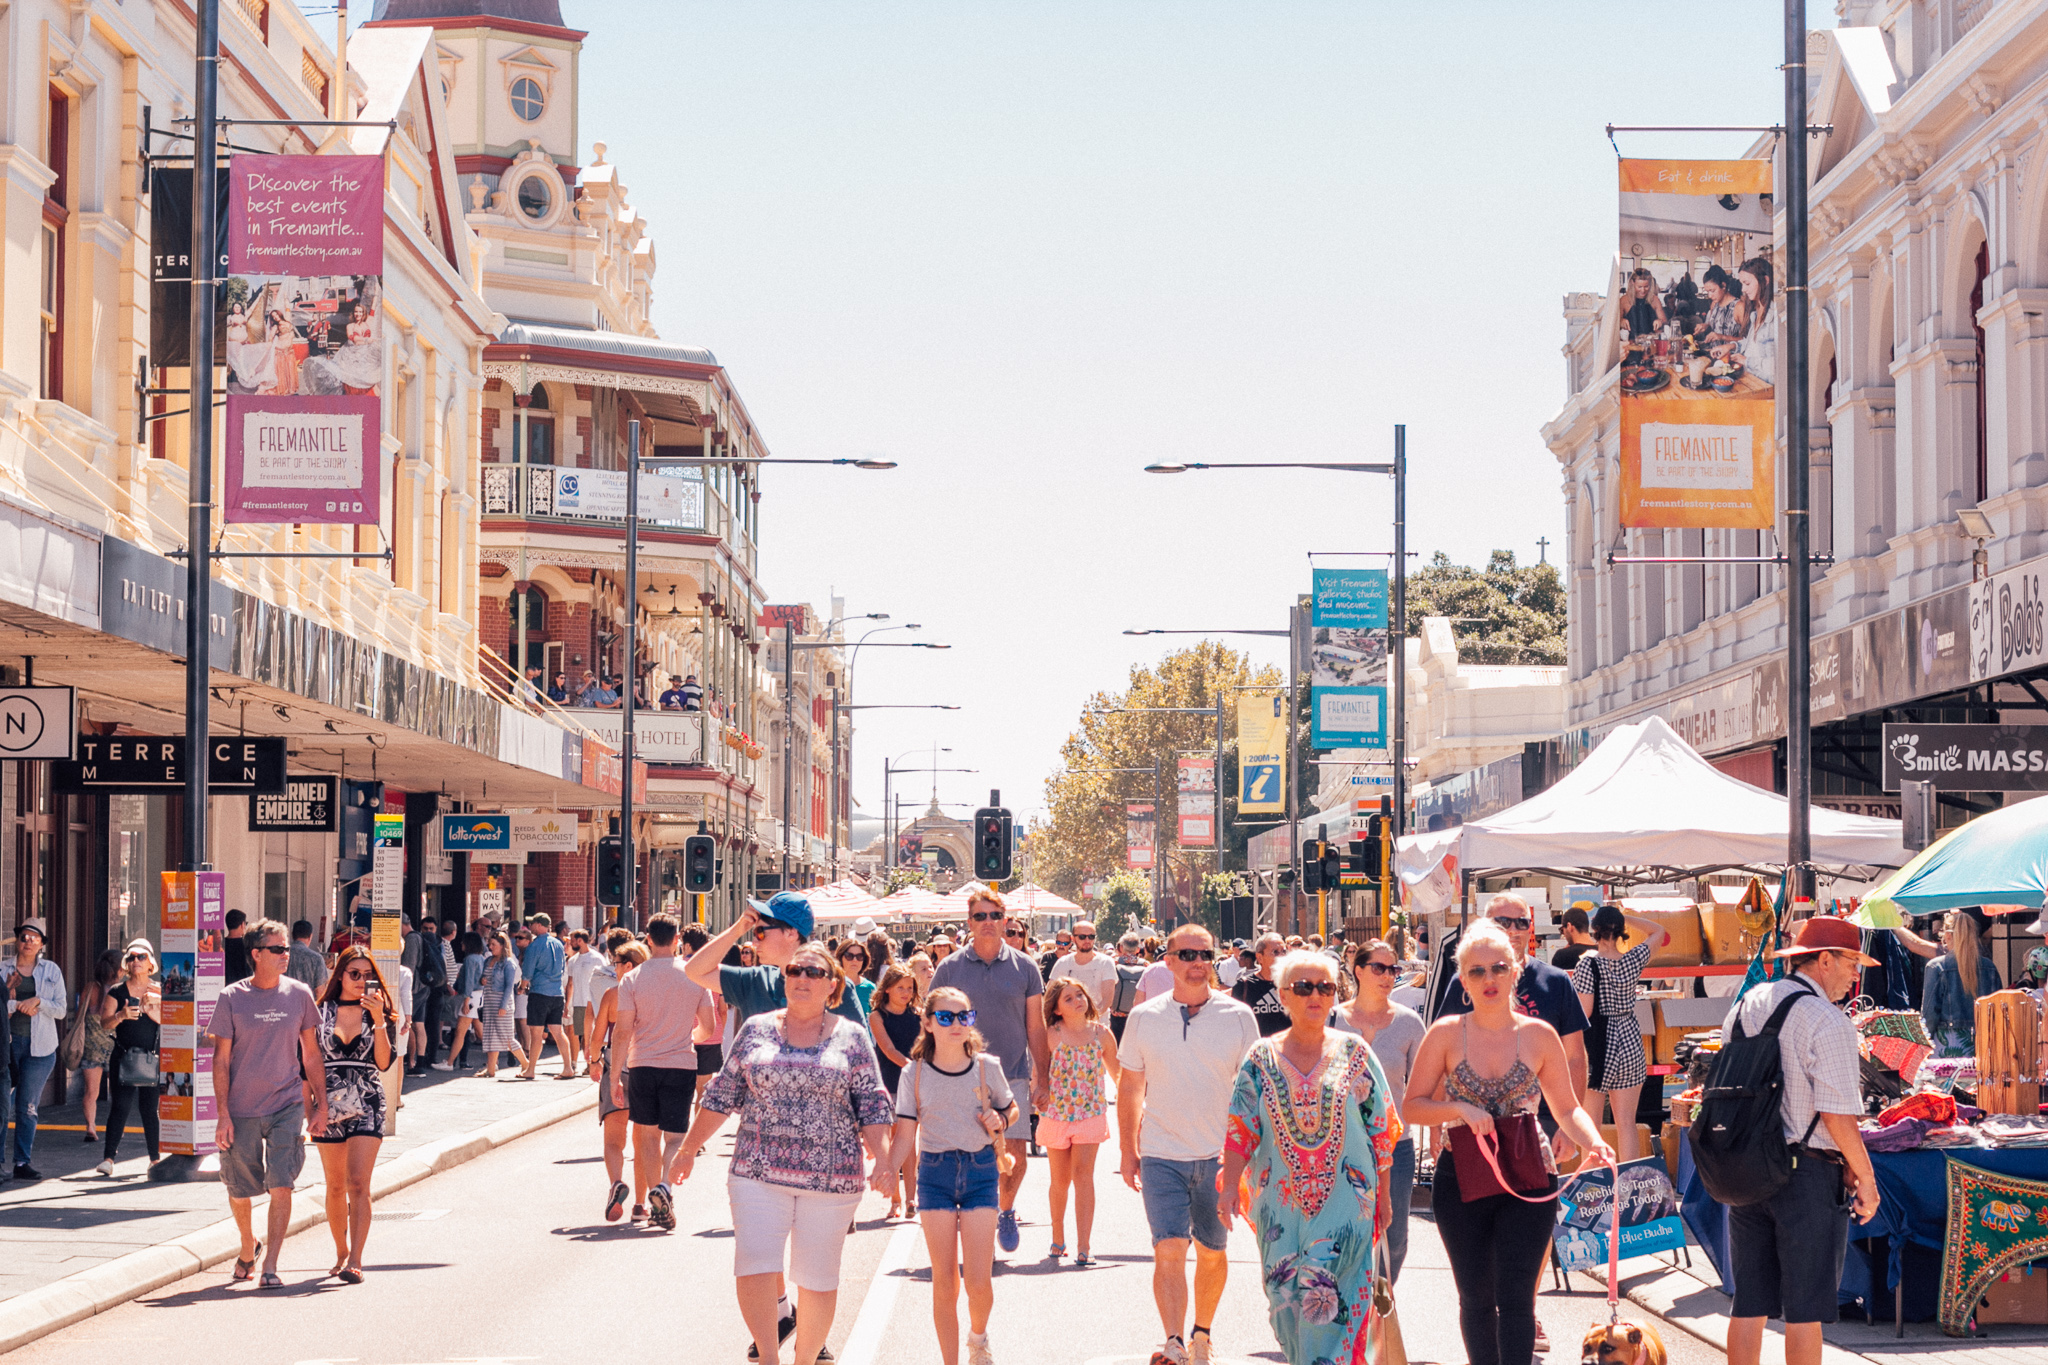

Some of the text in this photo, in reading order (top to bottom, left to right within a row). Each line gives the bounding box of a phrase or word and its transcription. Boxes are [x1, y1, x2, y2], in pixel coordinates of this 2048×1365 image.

[247, 173, 361, 192] Discover the
[1658, 169, 1734, 185] Eat & drink
[247, 196, 347, 215] best events
[247, 217, 364, 236] in Fremantle...
[246, 243, 362, 262] fremantlestory.com.au
[259, 426, 348, 452] FREMANTLE
[1655, 436, 1739, 462] FREMANTLE
[260, 457, 347, 469] BE PART OF THE STORY
[260, 473, 347, 481] fremantlestory.com.au
[1656, 466, 1665, 477] BE
[1668, 466, 1686, 477] PART
[1700, 466, 1713, 477] THE
[1716, 466, 1739, 478] STORY
[563, 479, 577, 490] CC
[242, 501, 309, 511] #fremantlestory
[1640, 499, 1753, 510] fremantlestory.com.au
[1318, 577, 1380, 588] Visit Fremantle
[1317, 589, 1383, 604] galleries, studios
[1318, 600, 1333, 609] and
[1999, 574, 2044, 673] Bob's
[1810, 653, 1839, 687] SSAGE
[1328, 701, 1372, 714] FREMANTLE
[6, 712, 25, 734] N
[1667, 708, 1717, 746] SWEAR
[641, 730, 690, 745] HOTEL
[84, 743, 256, 761] TERRCE
[1248, 754, 1270, 762] 200M
[1893, 742, 2048, 772] Smile MASS
[1380, 776, 1394, 785] STATI
[256, 801, 311, 820] EMPIRE
[449, 825, 503, 843] lotterywest
[513, 833, 573, 842] TOBACCONIST
[483, 892, 499, 900] ONE
[1253, 1003, 1284, 1014] adida
[1621, 1182, 1629, 1192] &
[1632, 1175, 1662, 1191] Tarot
[1631, 1193, 1663, 1207] Today
[1621, 1230, 1643, 1244] Blue
[1643, 1224, 1674, 1239] Budha
